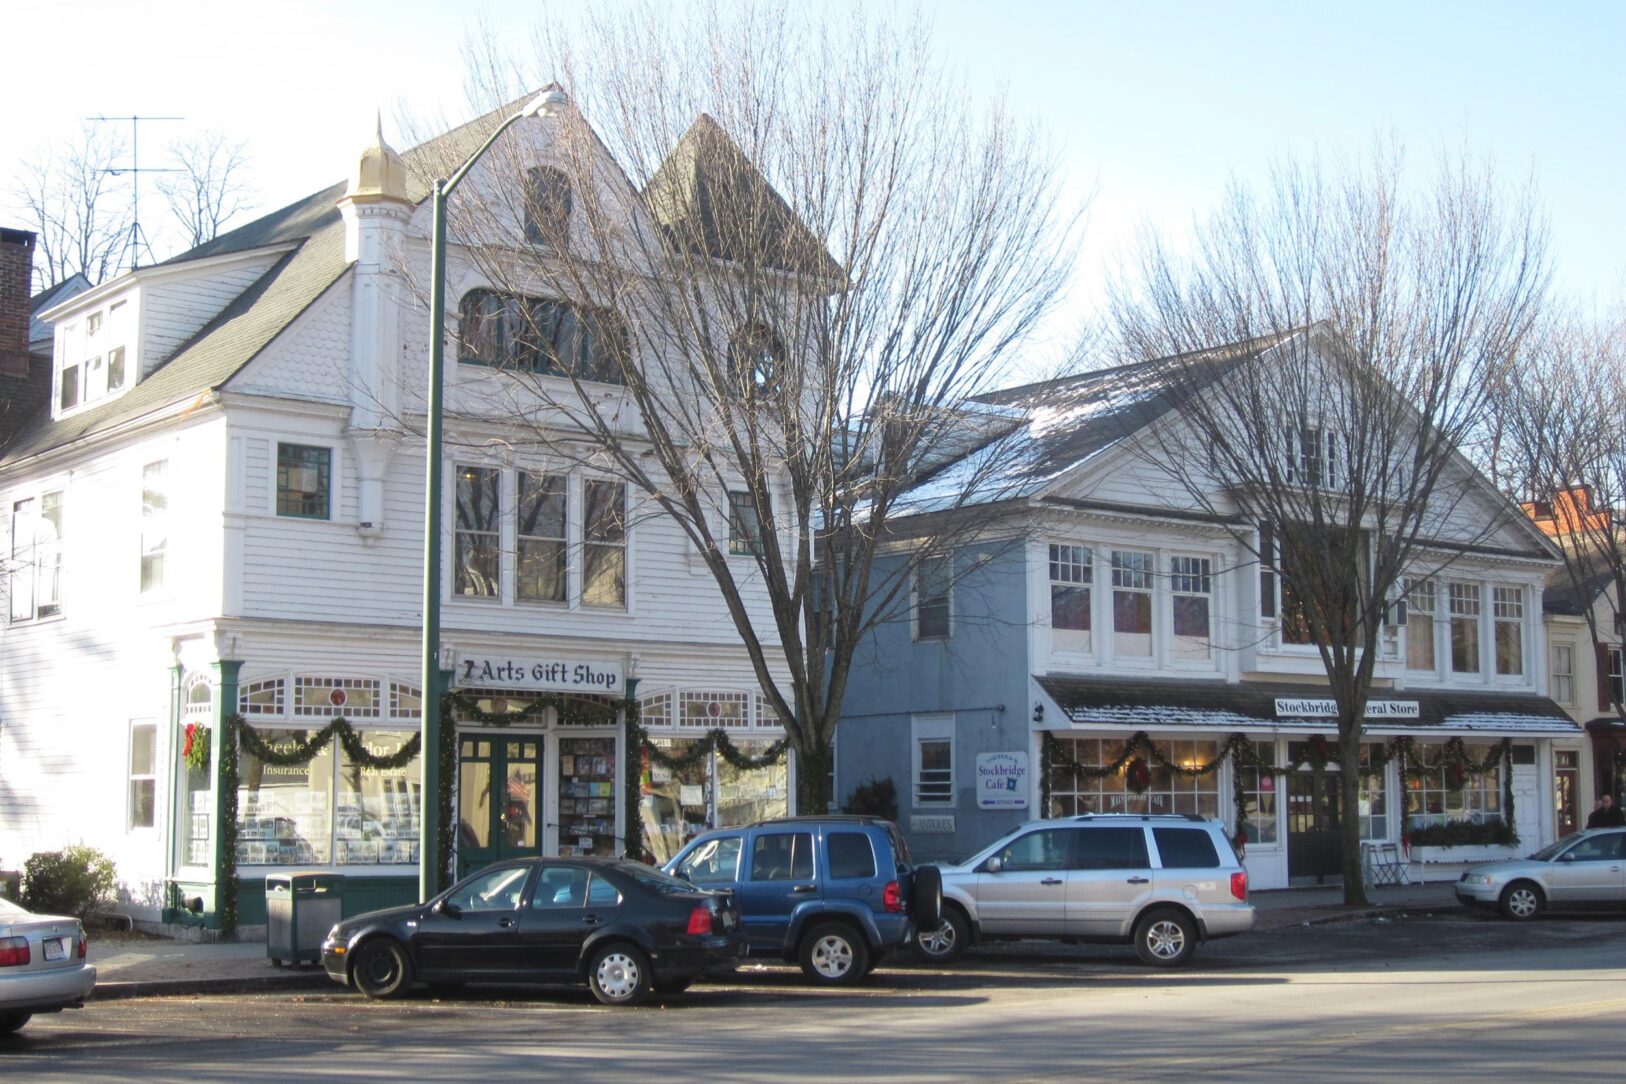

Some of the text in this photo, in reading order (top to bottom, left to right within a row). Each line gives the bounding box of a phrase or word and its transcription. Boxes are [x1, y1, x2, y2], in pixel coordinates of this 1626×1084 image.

[463, 660, 617, 689] 7 Arts Gift Shop
[1276, 700, 1338, 715] Stockbridg
[1389, 703, 1418, 715] Store
[263, 764, 311, 776] Insurance
[978, 764, 1026, 777] Stockbridge
